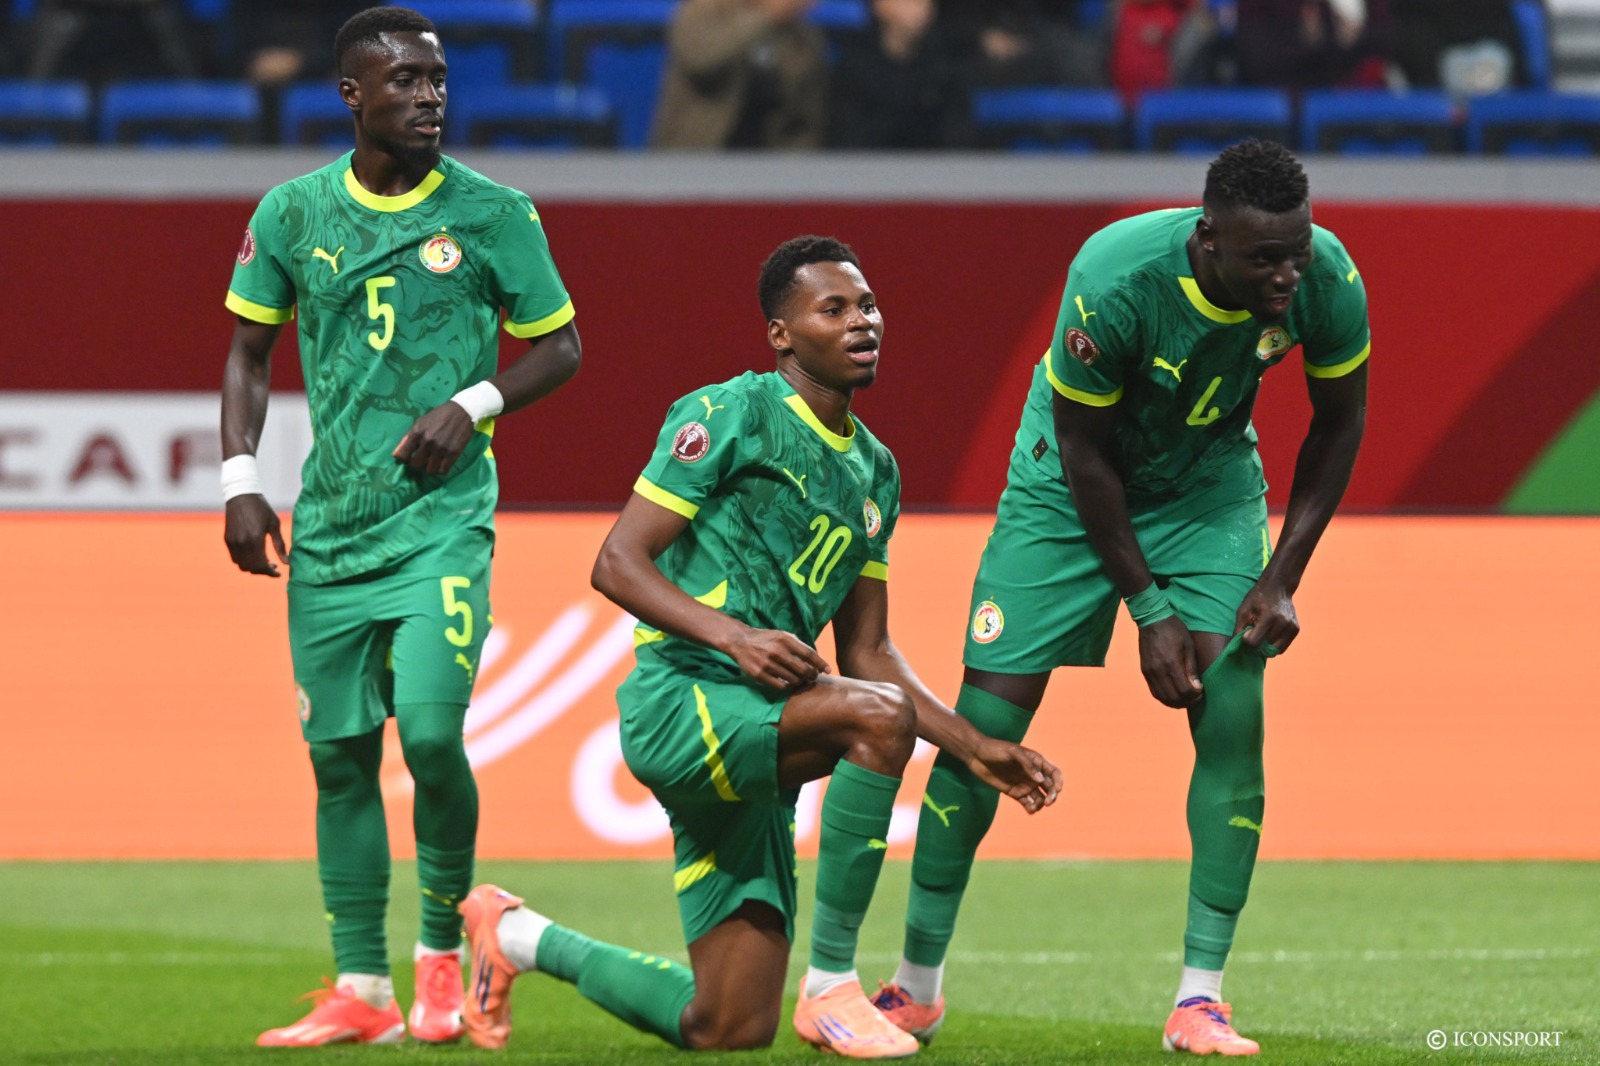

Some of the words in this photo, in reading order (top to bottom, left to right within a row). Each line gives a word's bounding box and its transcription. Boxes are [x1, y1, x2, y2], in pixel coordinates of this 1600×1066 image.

[365, 276, 396, 350] 5
[788, 514, 853, 594] 20
[440, 575, 473, 648] 5
